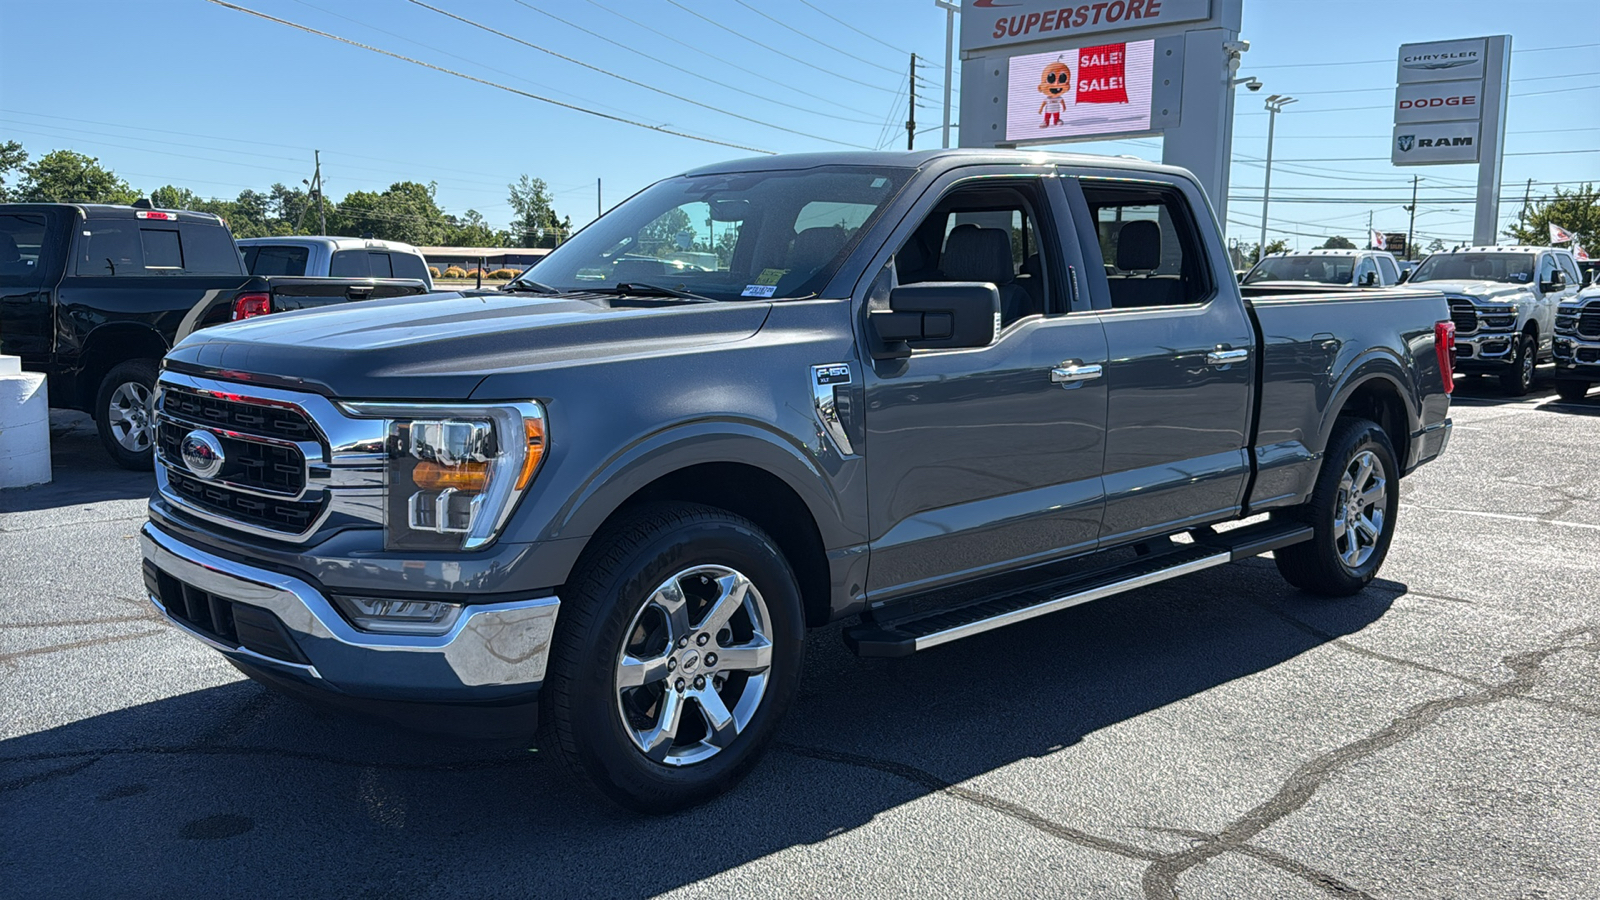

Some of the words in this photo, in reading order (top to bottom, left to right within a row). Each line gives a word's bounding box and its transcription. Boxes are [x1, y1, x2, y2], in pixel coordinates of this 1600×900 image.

[992, 0, 1161, 39] SUPERSTORE
[1080, 51, 1123, 67] SALE!
[1404, 51, 1477, 62] CHRYSLER
[1078, 76, 1124, 92] SALE!
[1399, 96, 1476, 109] DODGE
[1418, 137, 1473, 147] RAM
[817, 367, 849, 377] F-150
